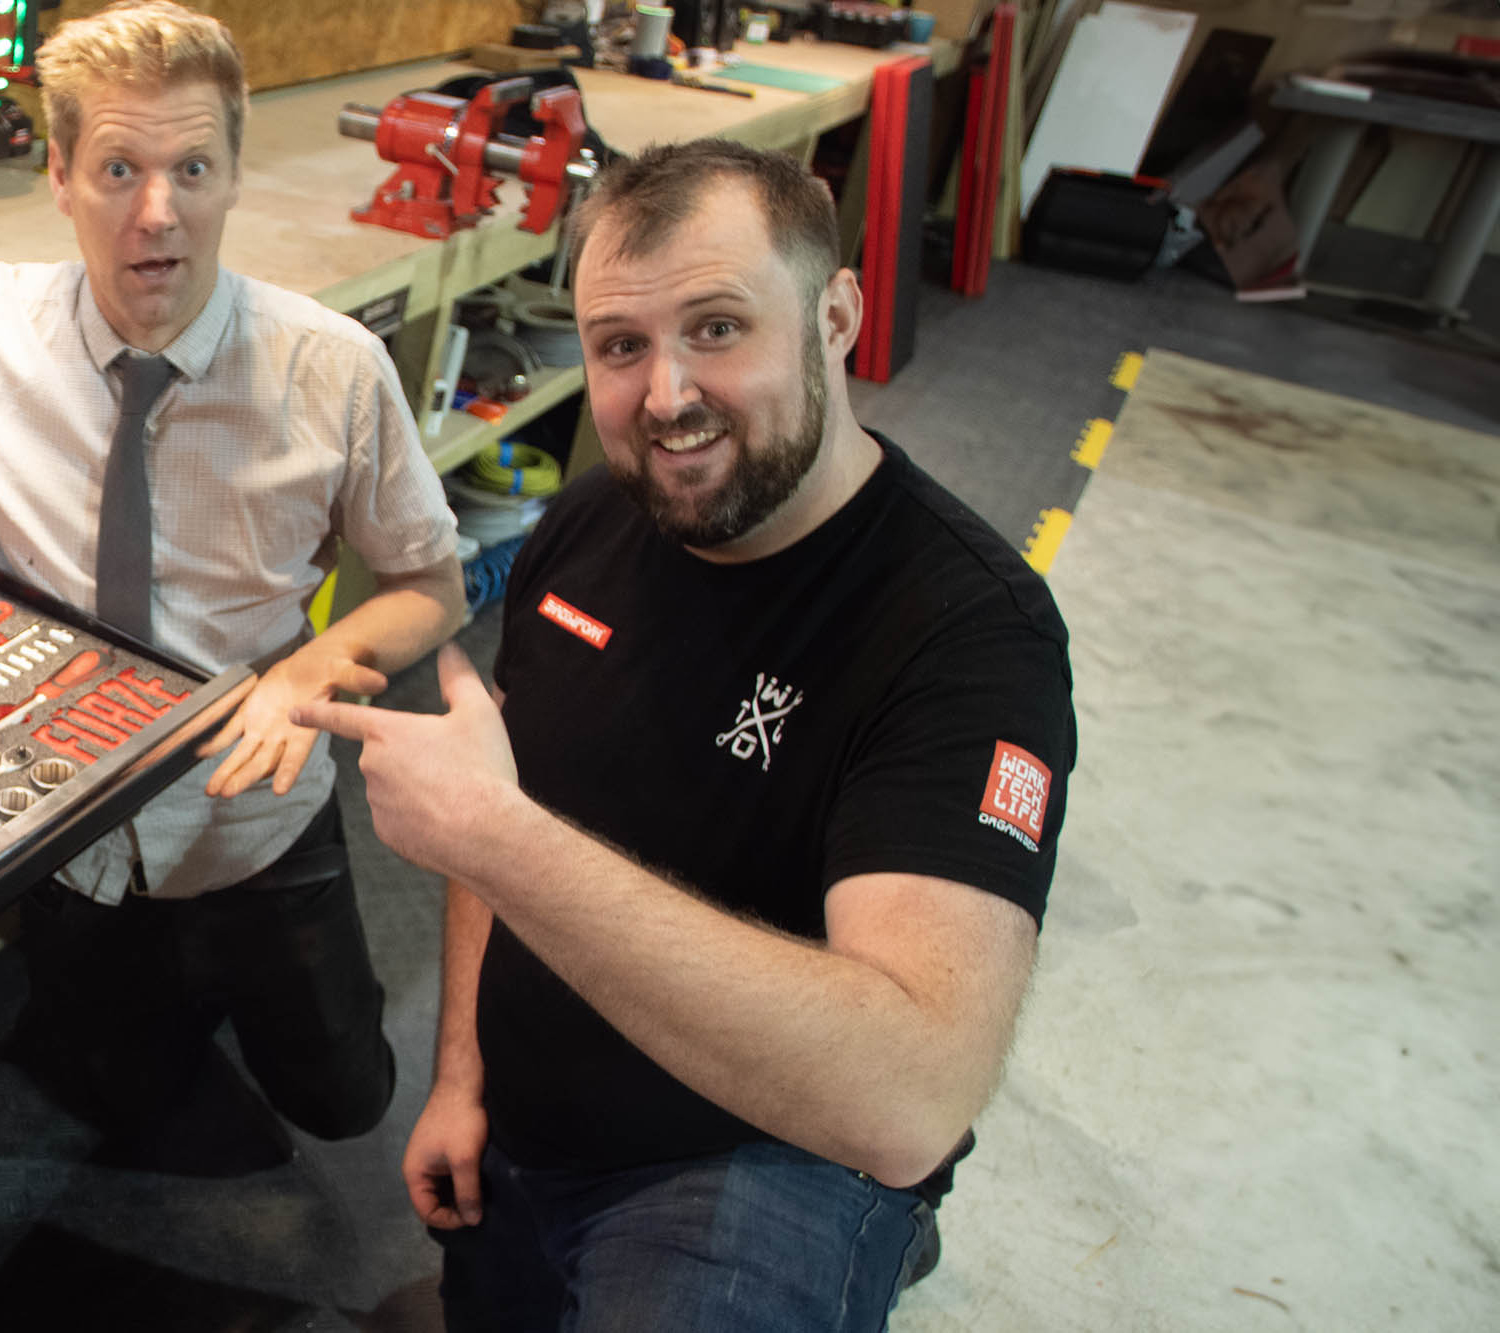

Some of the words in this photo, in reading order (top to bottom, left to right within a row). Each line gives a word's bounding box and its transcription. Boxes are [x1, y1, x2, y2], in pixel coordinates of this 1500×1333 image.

[998, 769, 1042, 813] TECH
[1000, 751, 1046, 796] WORK
[994, 789, 1040, 832] LIFE
